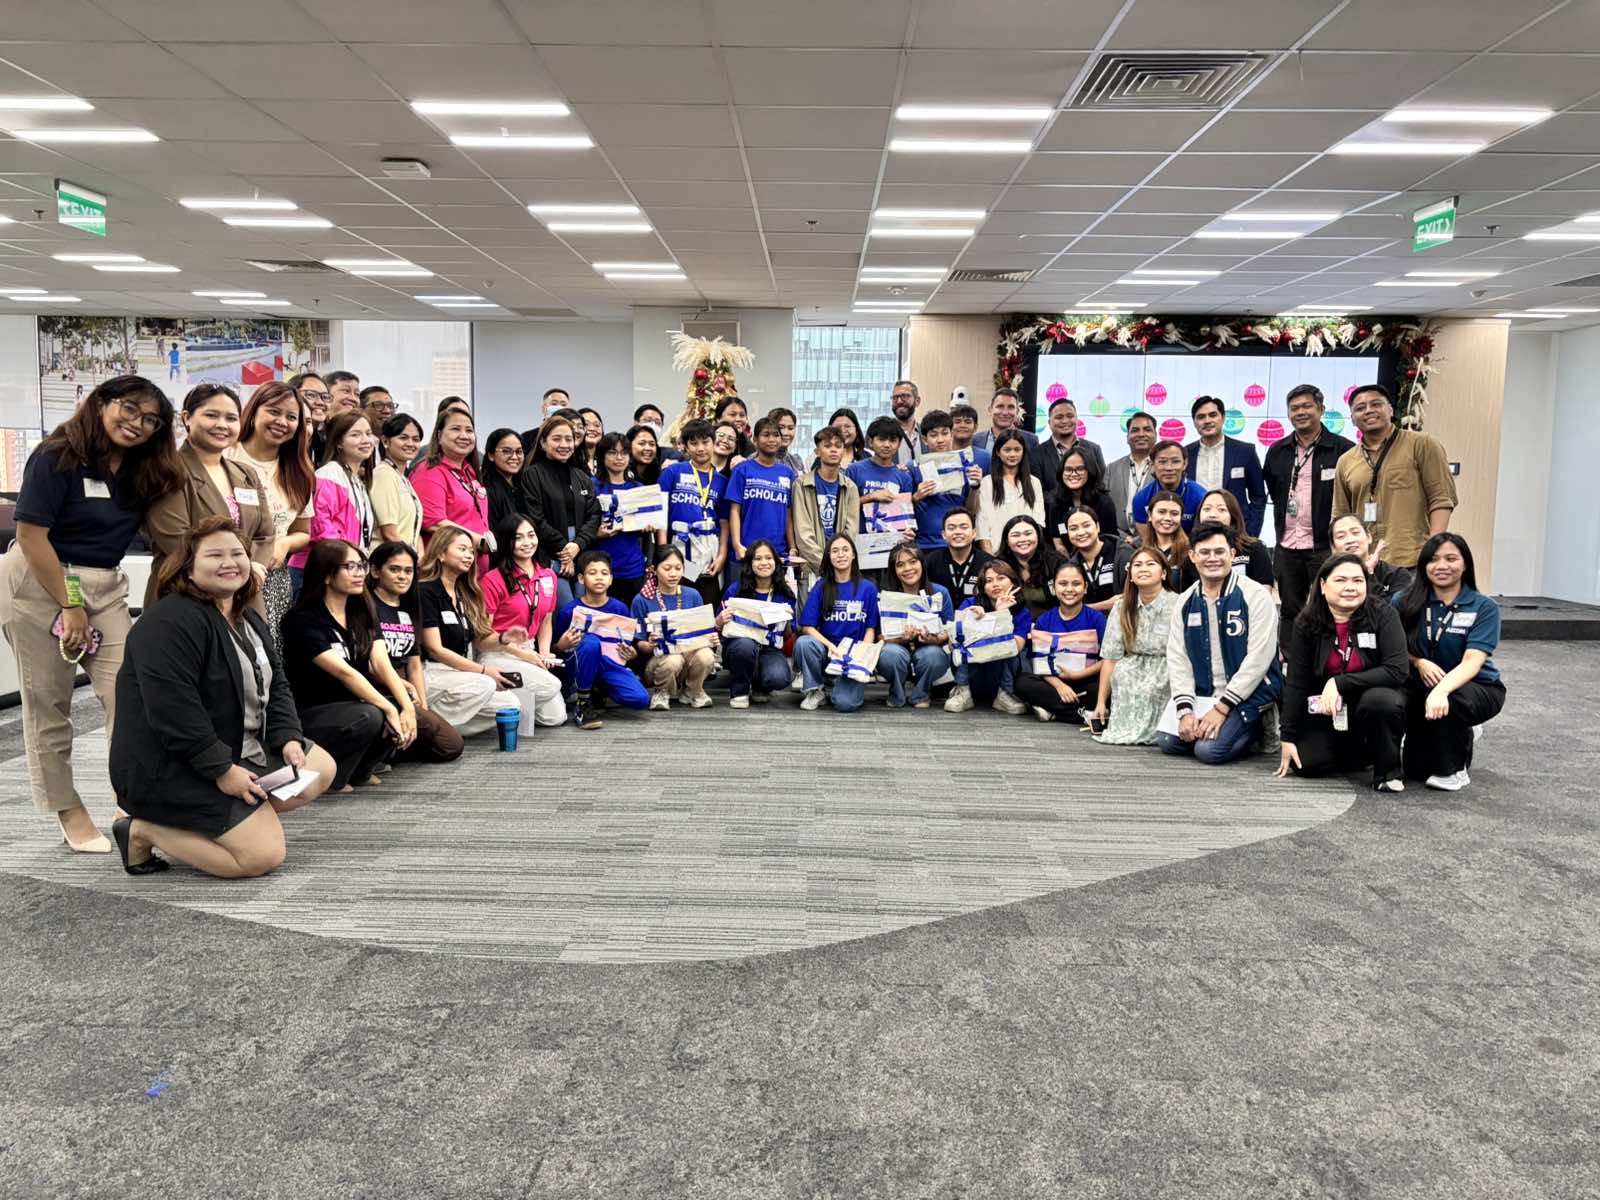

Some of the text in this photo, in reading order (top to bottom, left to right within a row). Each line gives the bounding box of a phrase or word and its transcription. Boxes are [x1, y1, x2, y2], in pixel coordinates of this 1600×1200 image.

[1416, 218, 1444, 244] EXIT
[671, 493, 714, 510] SCHOA
[1226, 610, 1244, 636] 5
